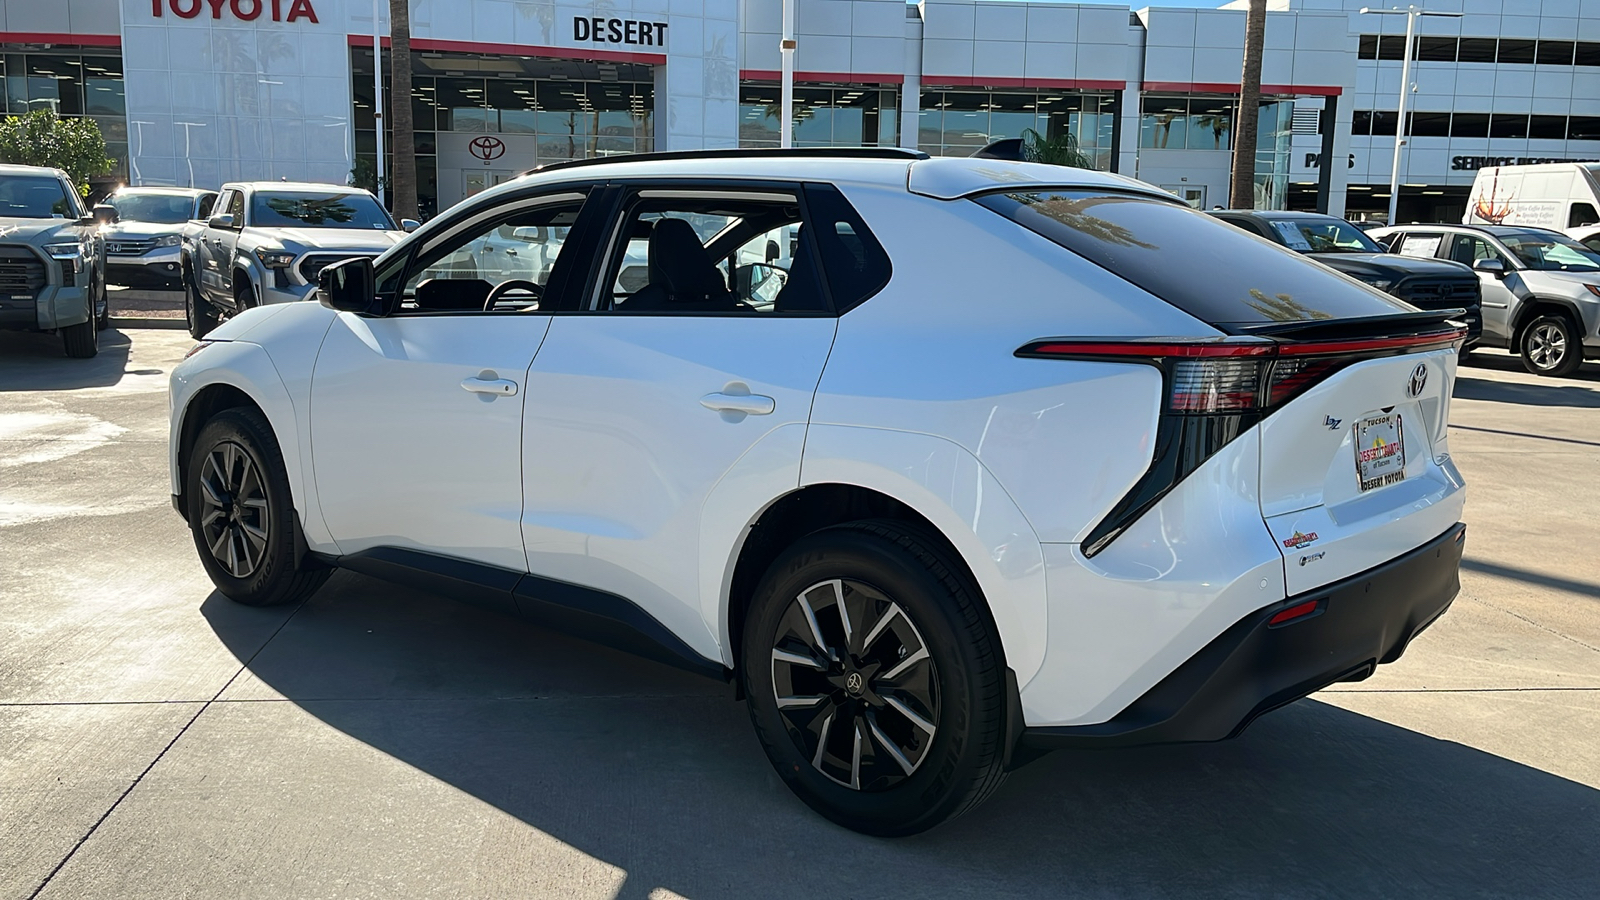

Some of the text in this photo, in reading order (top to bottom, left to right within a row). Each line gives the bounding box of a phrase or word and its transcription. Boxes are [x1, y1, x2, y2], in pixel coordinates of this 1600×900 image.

[573, 16, 668, 46] DESERT
[1451, 156, 1515, 170] SERVICE
[1367, 416, 1391, 427] TUCSON
[1360, 447, 1379, 463] DESERT
[1378, 459, 1391, 467] Tucson
[1363, 471, 1405, 491] DESERT TOYOTA
